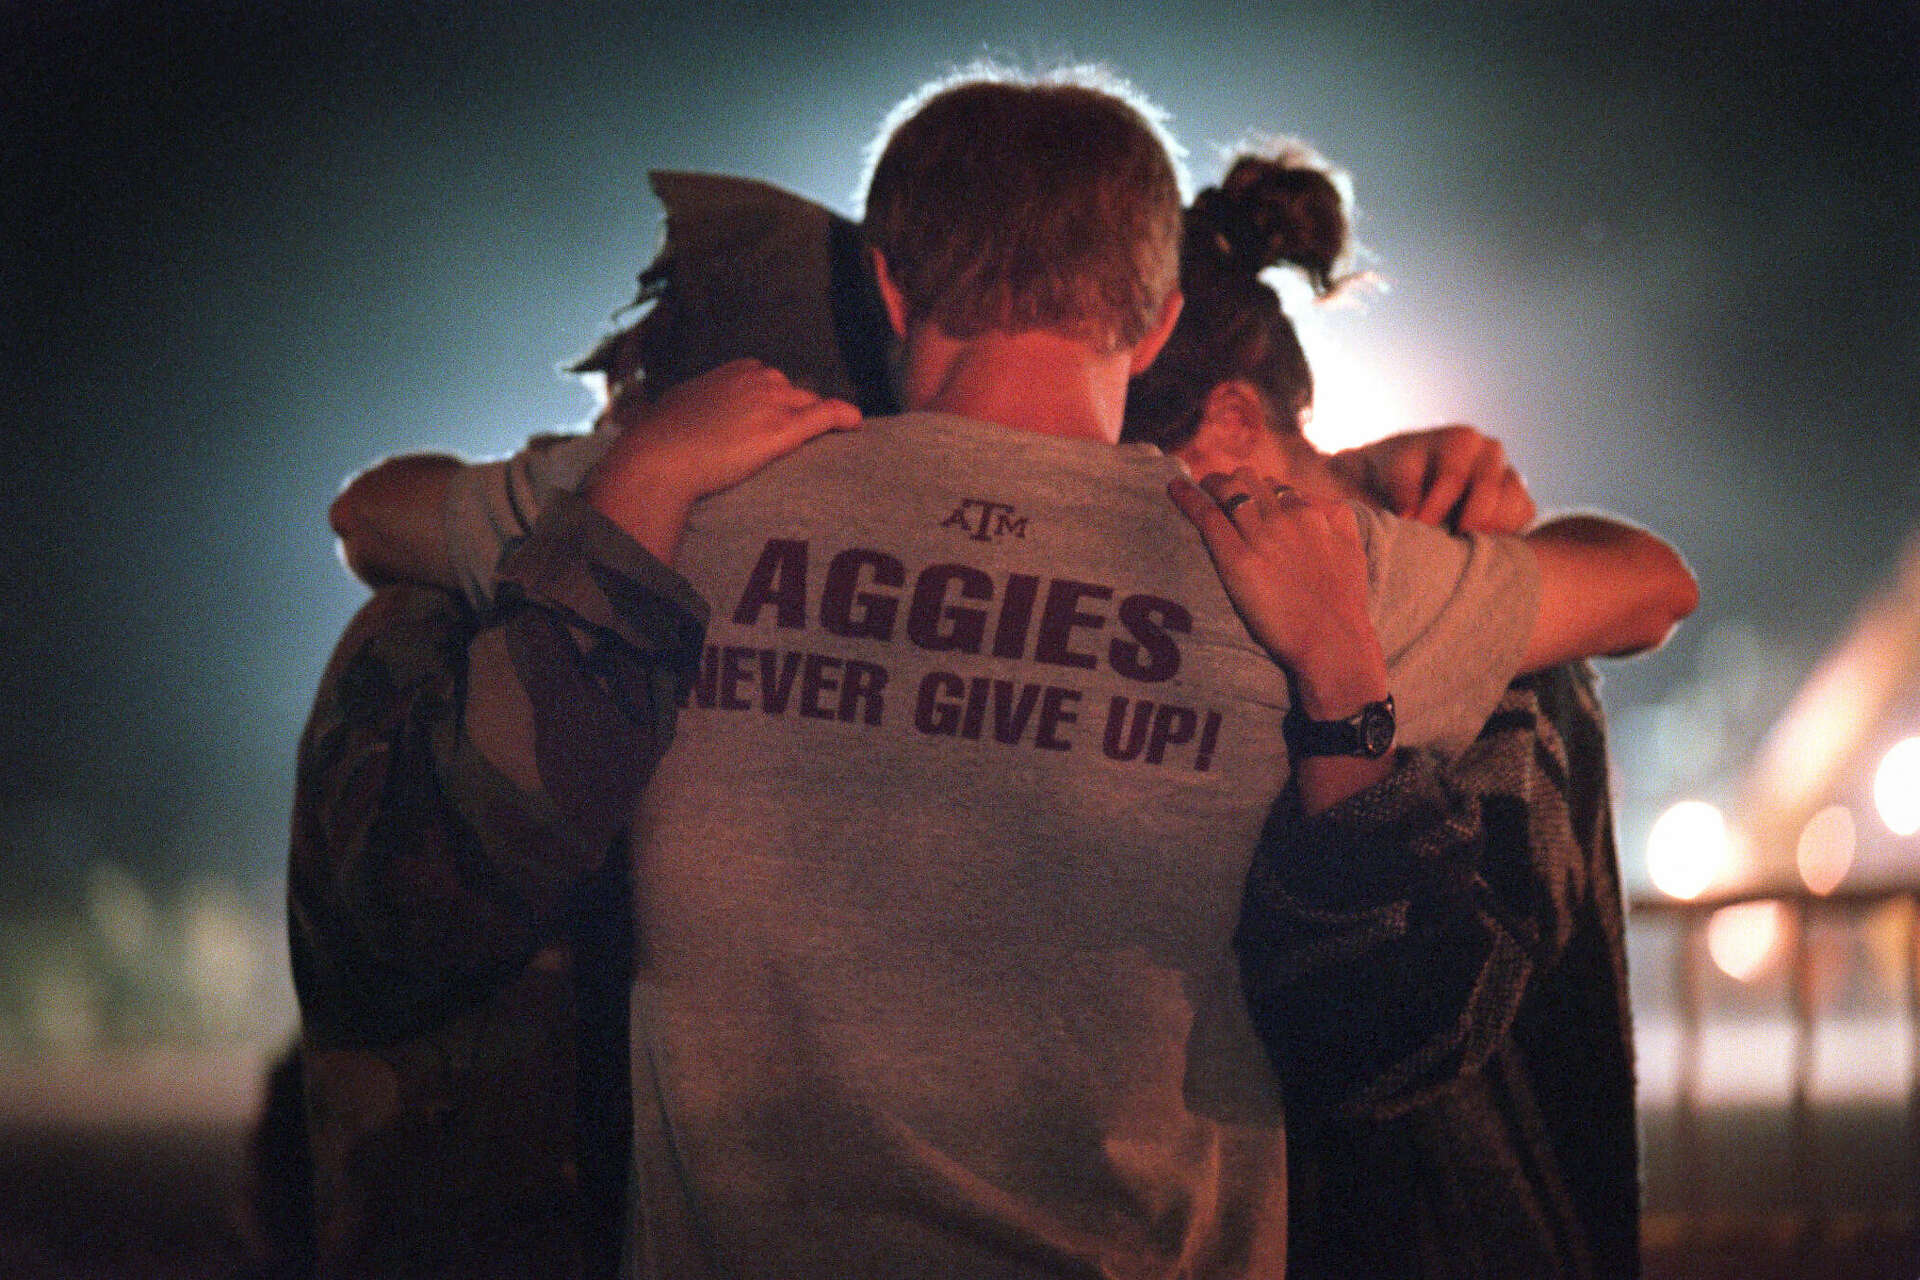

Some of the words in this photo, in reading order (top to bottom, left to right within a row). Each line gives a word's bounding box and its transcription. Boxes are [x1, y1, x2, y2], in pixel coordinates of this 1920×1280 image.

[732, 538, 1194, 683] AGGIES
[678, 645, 888, 727] NEVER
[915, 671, 1082, 752] GIVE
[1102, 696, 1222, 772] UP!
